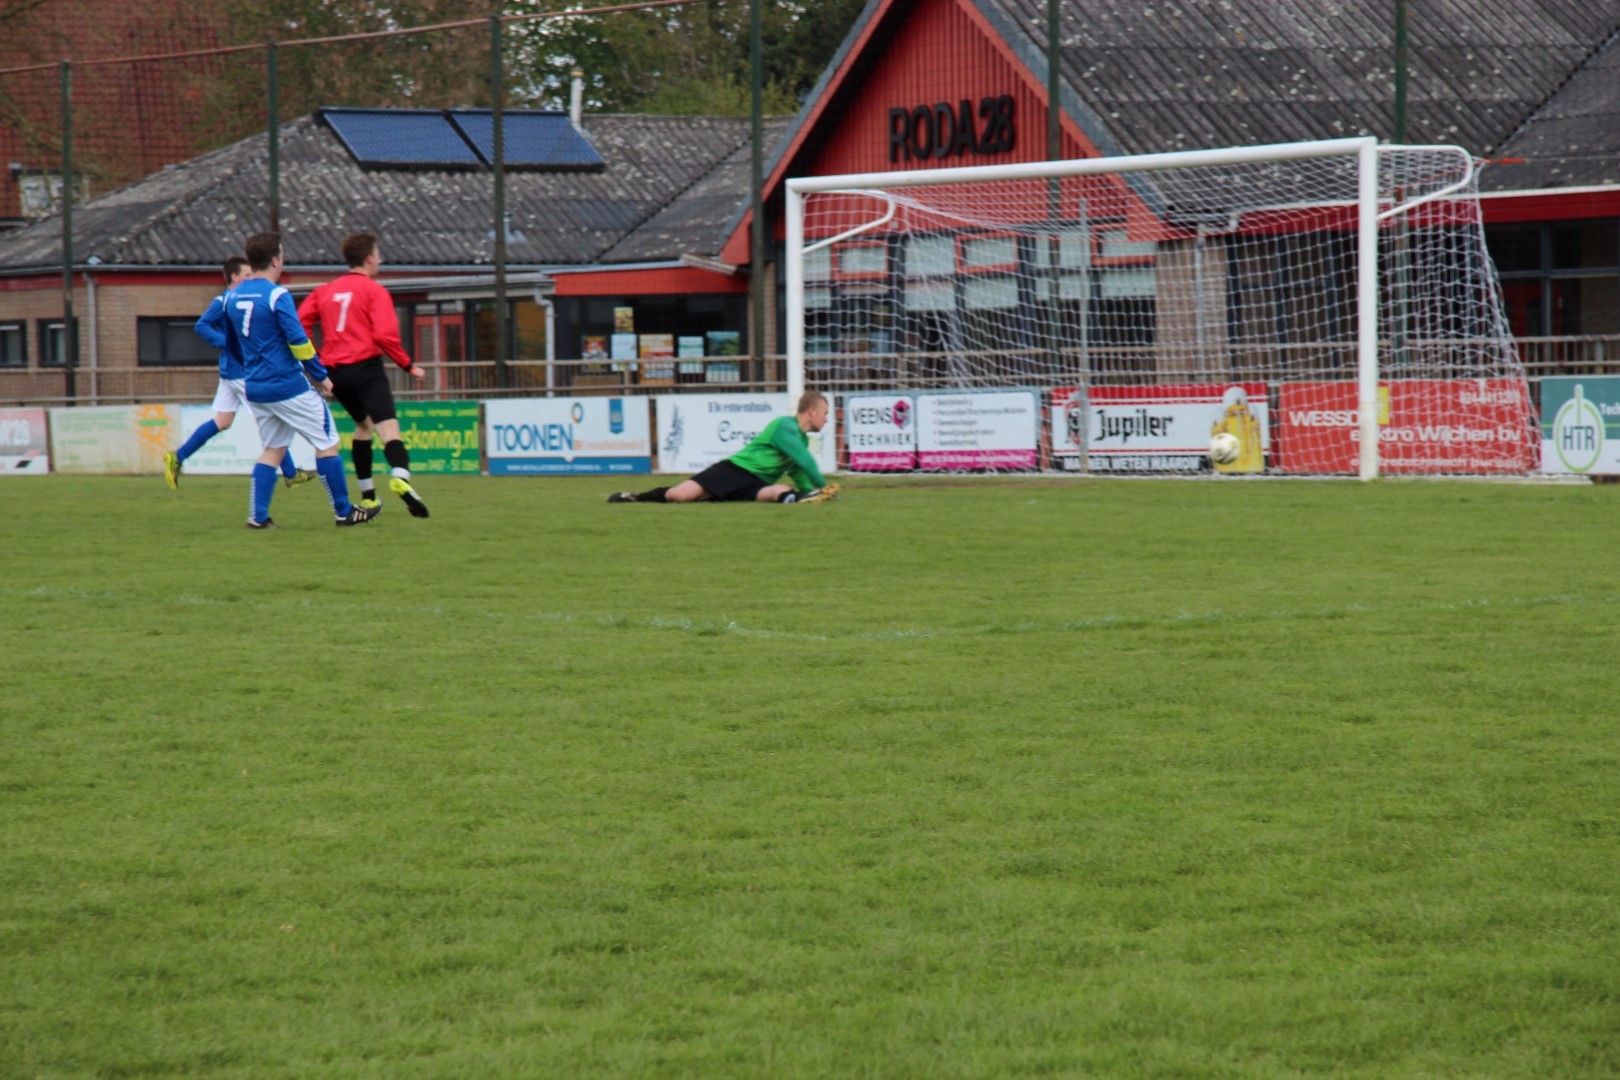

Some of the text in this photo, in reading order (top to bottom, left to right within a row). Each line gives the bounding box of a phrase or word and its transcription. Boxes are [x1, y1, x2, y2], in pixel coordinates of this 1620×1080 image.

[236, 300, 254, 337] 7
[333, 292, 353, 332] 7
[852, 407, 892, 424] VEENS
[1094, 409, 1174, 442] Jupiler
[493, 424, 573, 450] TOONEN
[852, 433, 912, 446] TECHNIEK
[1350, 425, 1521, 445] ektro Wijchen bv
[1563, 426, 1595, 450] HTR
[1064, 456, 1110, 471] MANEN
